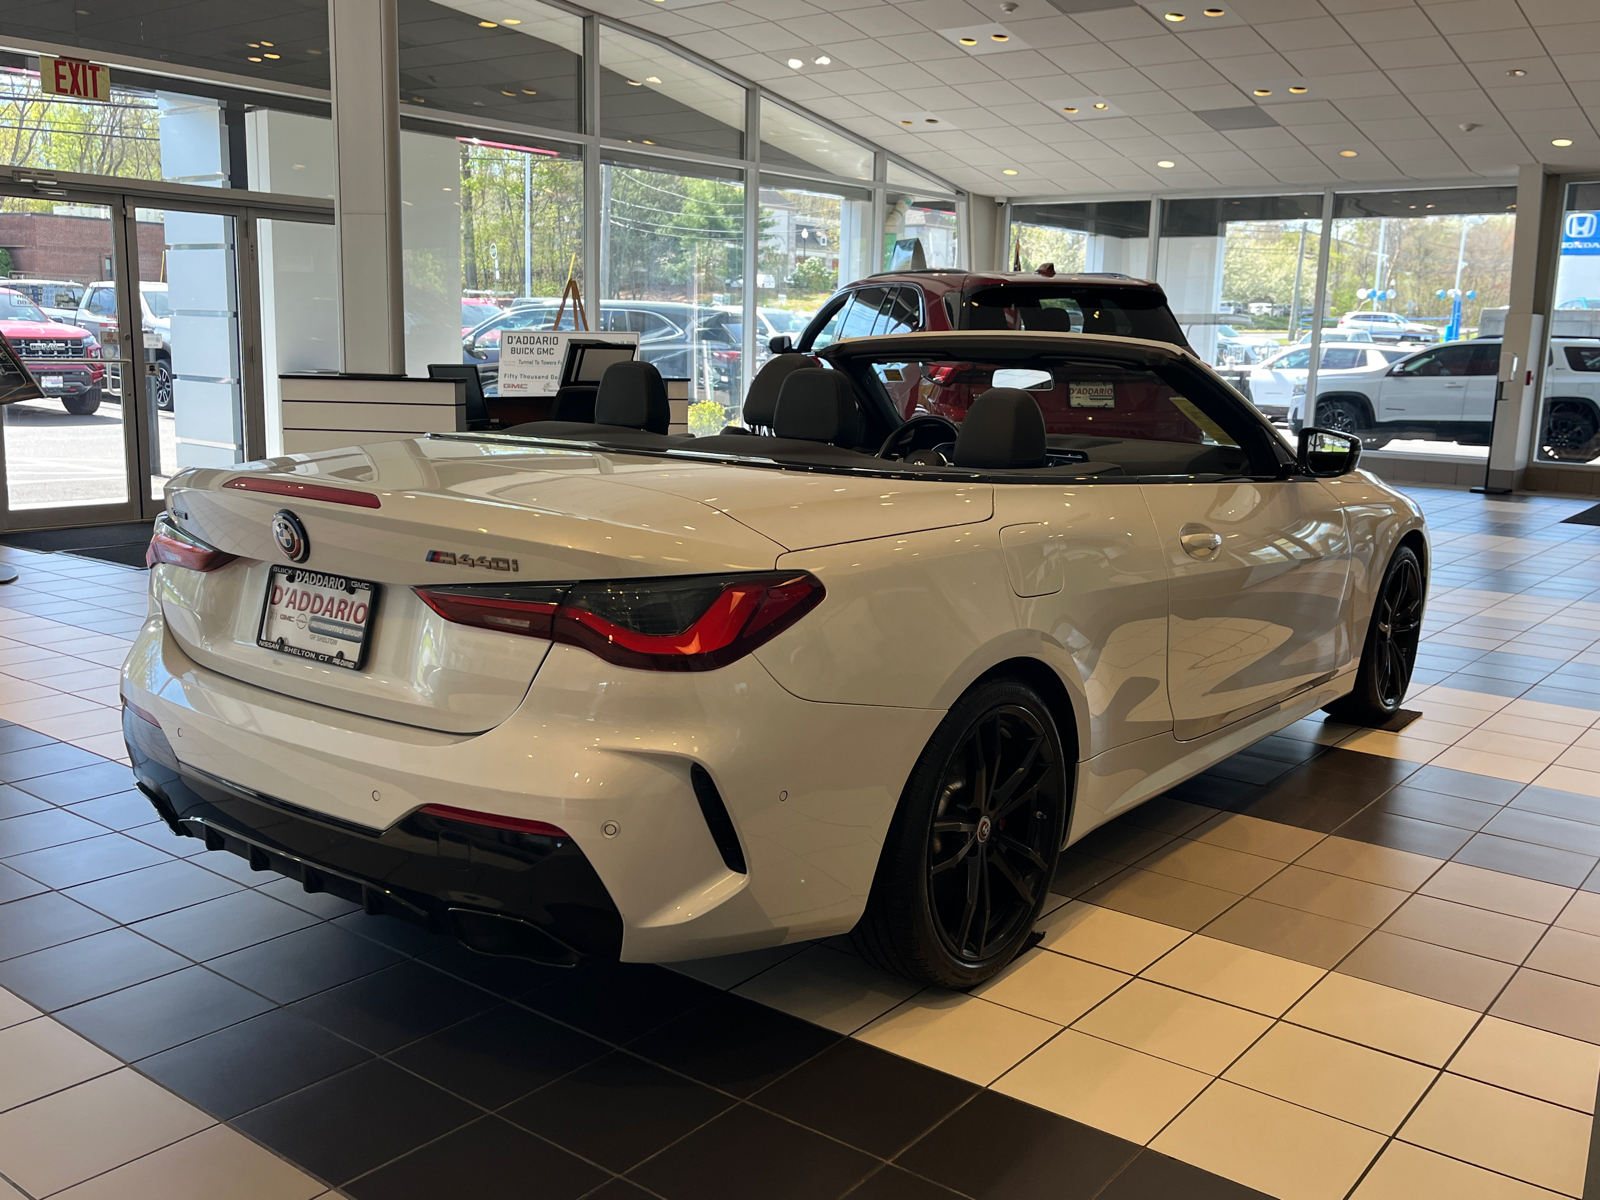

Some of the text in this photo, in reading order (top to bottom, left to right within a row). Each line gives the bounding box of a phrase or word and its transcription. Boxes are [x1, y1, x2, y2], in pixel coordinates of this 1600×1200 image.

[54, 60, 100, 98] EXIT
[507, 335, 559, 346] D'ADDARIO
[510, 347, 555, 356] BUICK GMC
[1069, 387, 1113, 395] D'ADDARIO
[425, 549, 519, 572] M440i
[273, 566, 370, 591] BUICK D'ADDARIO GMC
[270, 584, 369, 624] D'ADDARIO
[310, 620, 362, 638] AUTOMOTIVE GROUP
[258, 640, 280, 650] NISSAN
[318, 654, 329, 662] CT
